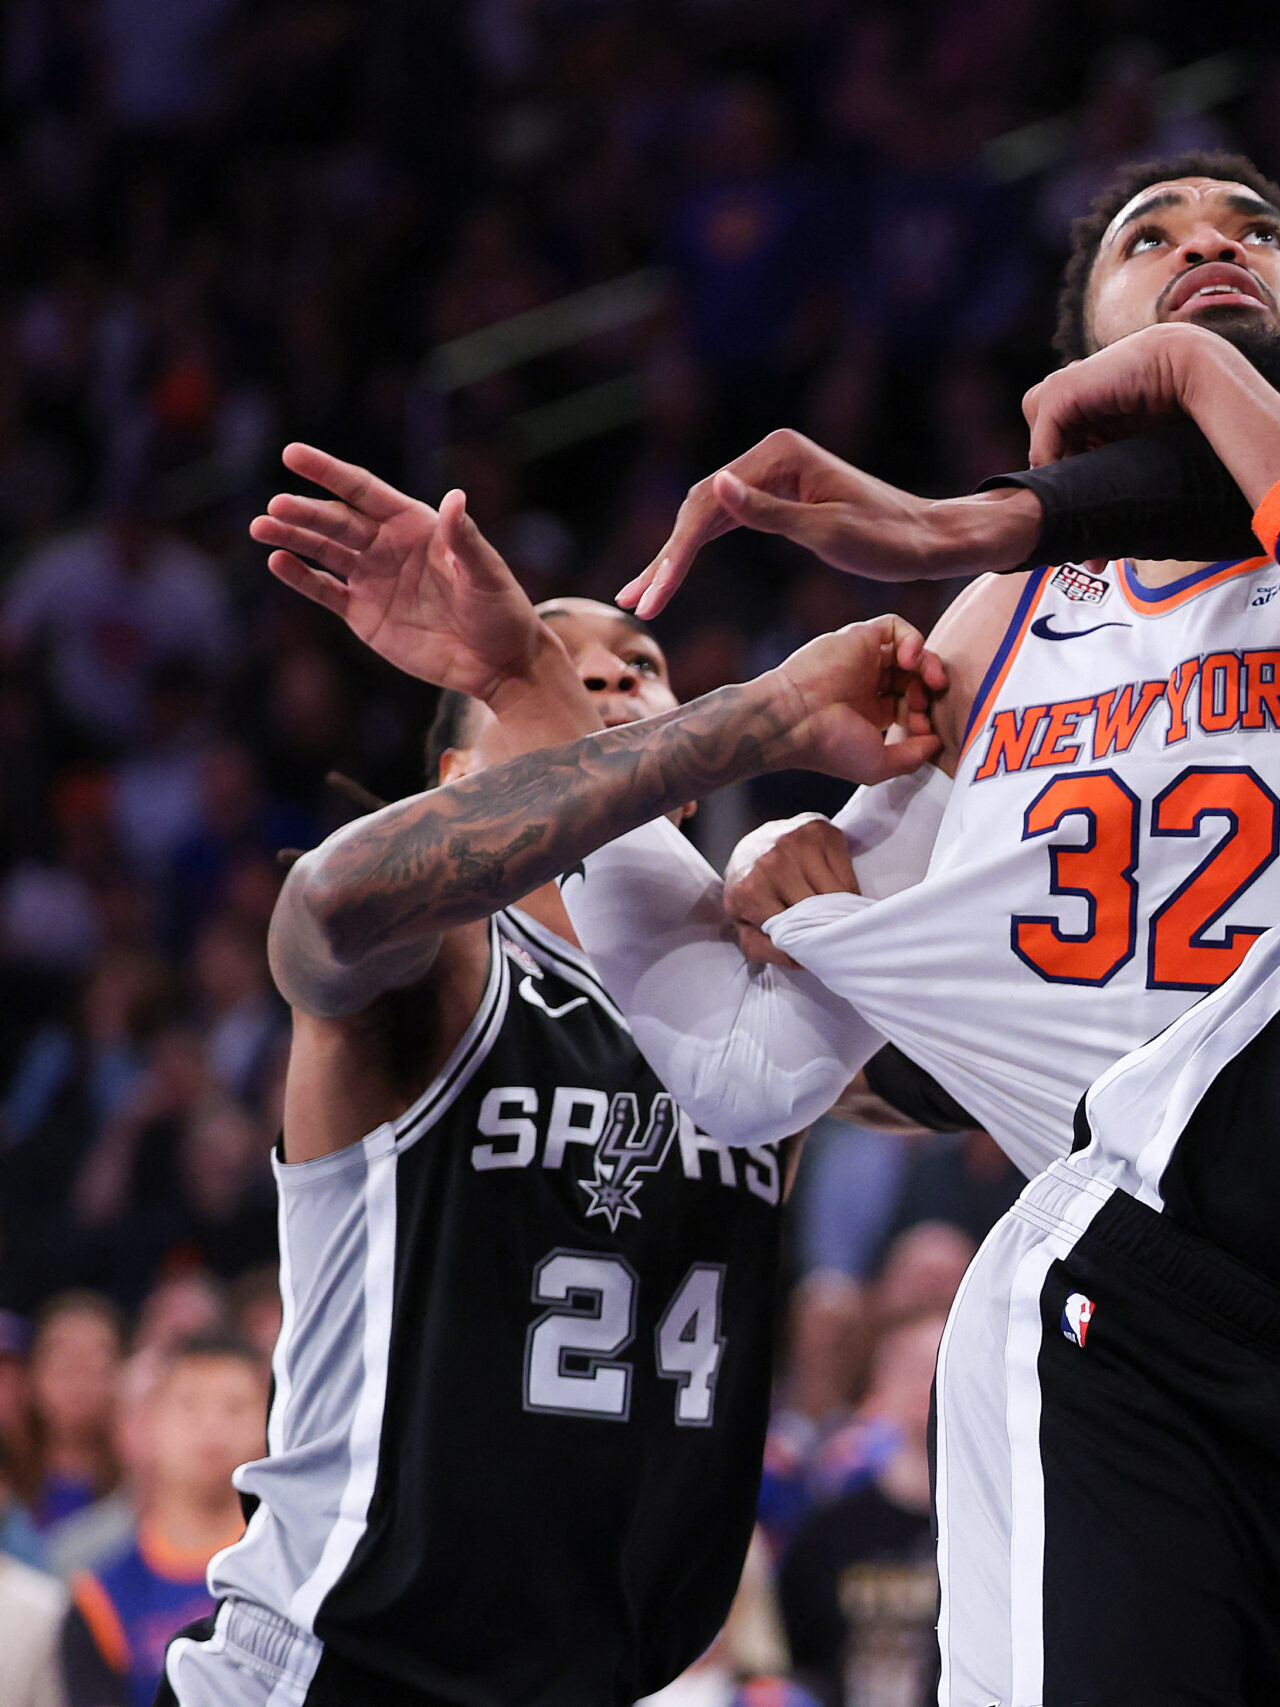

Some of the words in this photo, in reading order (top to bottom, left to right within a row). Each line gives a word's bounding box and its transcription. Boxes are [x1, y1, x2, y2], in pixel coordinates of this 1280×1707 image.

[1061, 566, 1105, 591] USA
[969, 678, 1170, 787] NEW
[522, 1246, 728, 1429] 24
